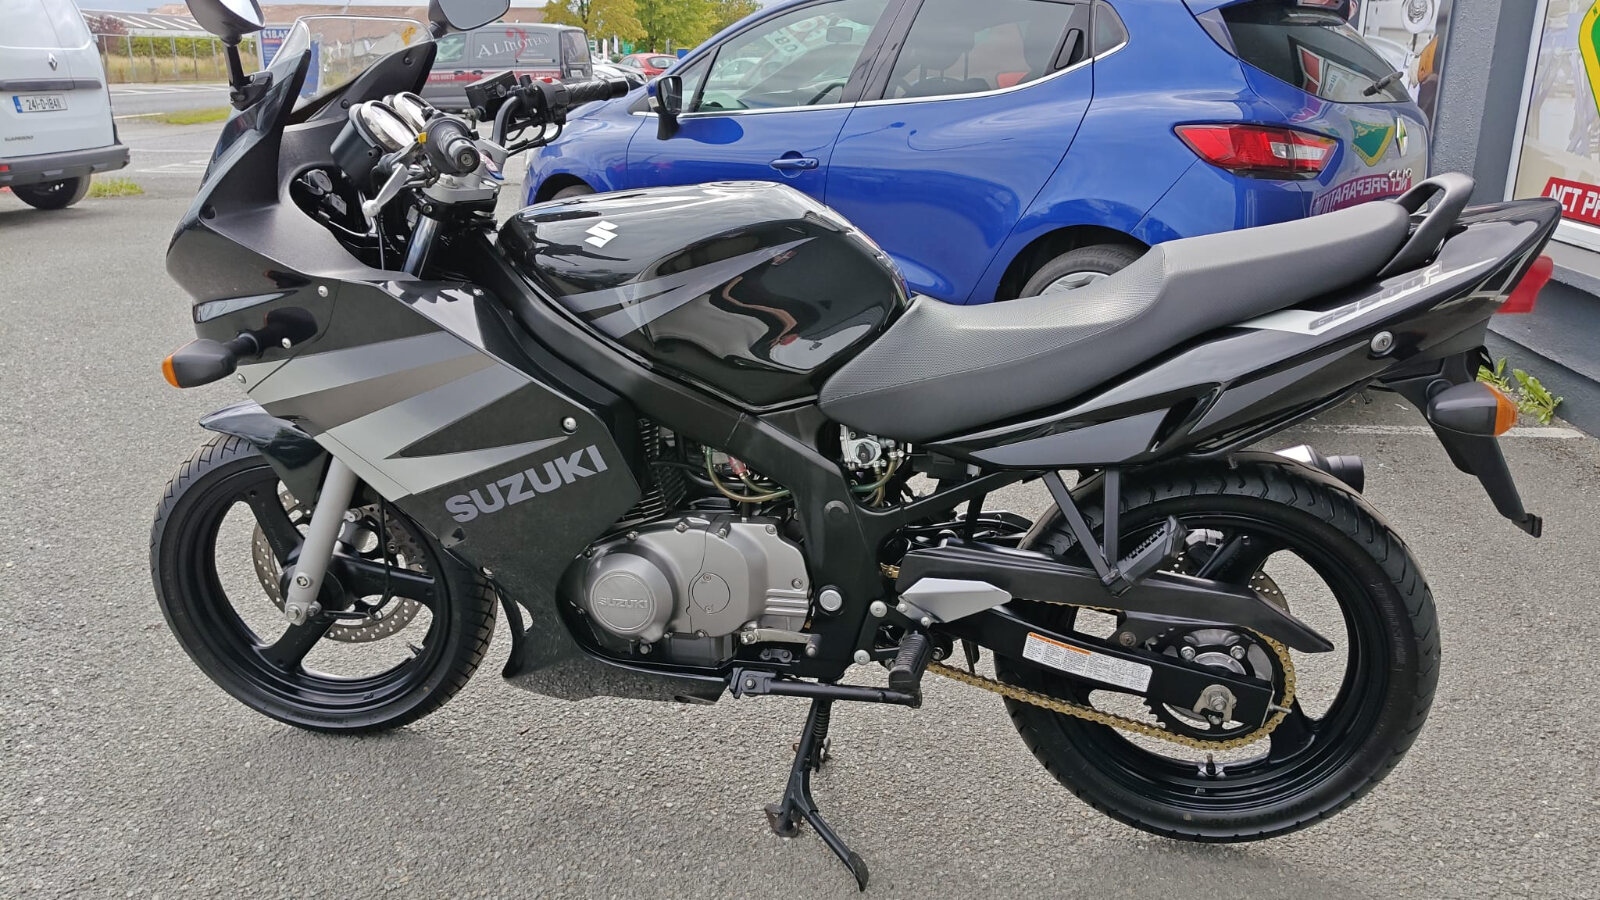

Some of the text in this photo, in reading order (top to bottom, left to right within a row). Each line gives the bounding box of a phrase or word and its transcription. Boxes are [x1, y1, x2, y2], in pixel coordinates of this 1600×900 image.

[1389, 168, 1412, 181] CLIO
[445, 444, 608, 523] SUZUKI
[597, 597, 648, 609] SUZUKI
